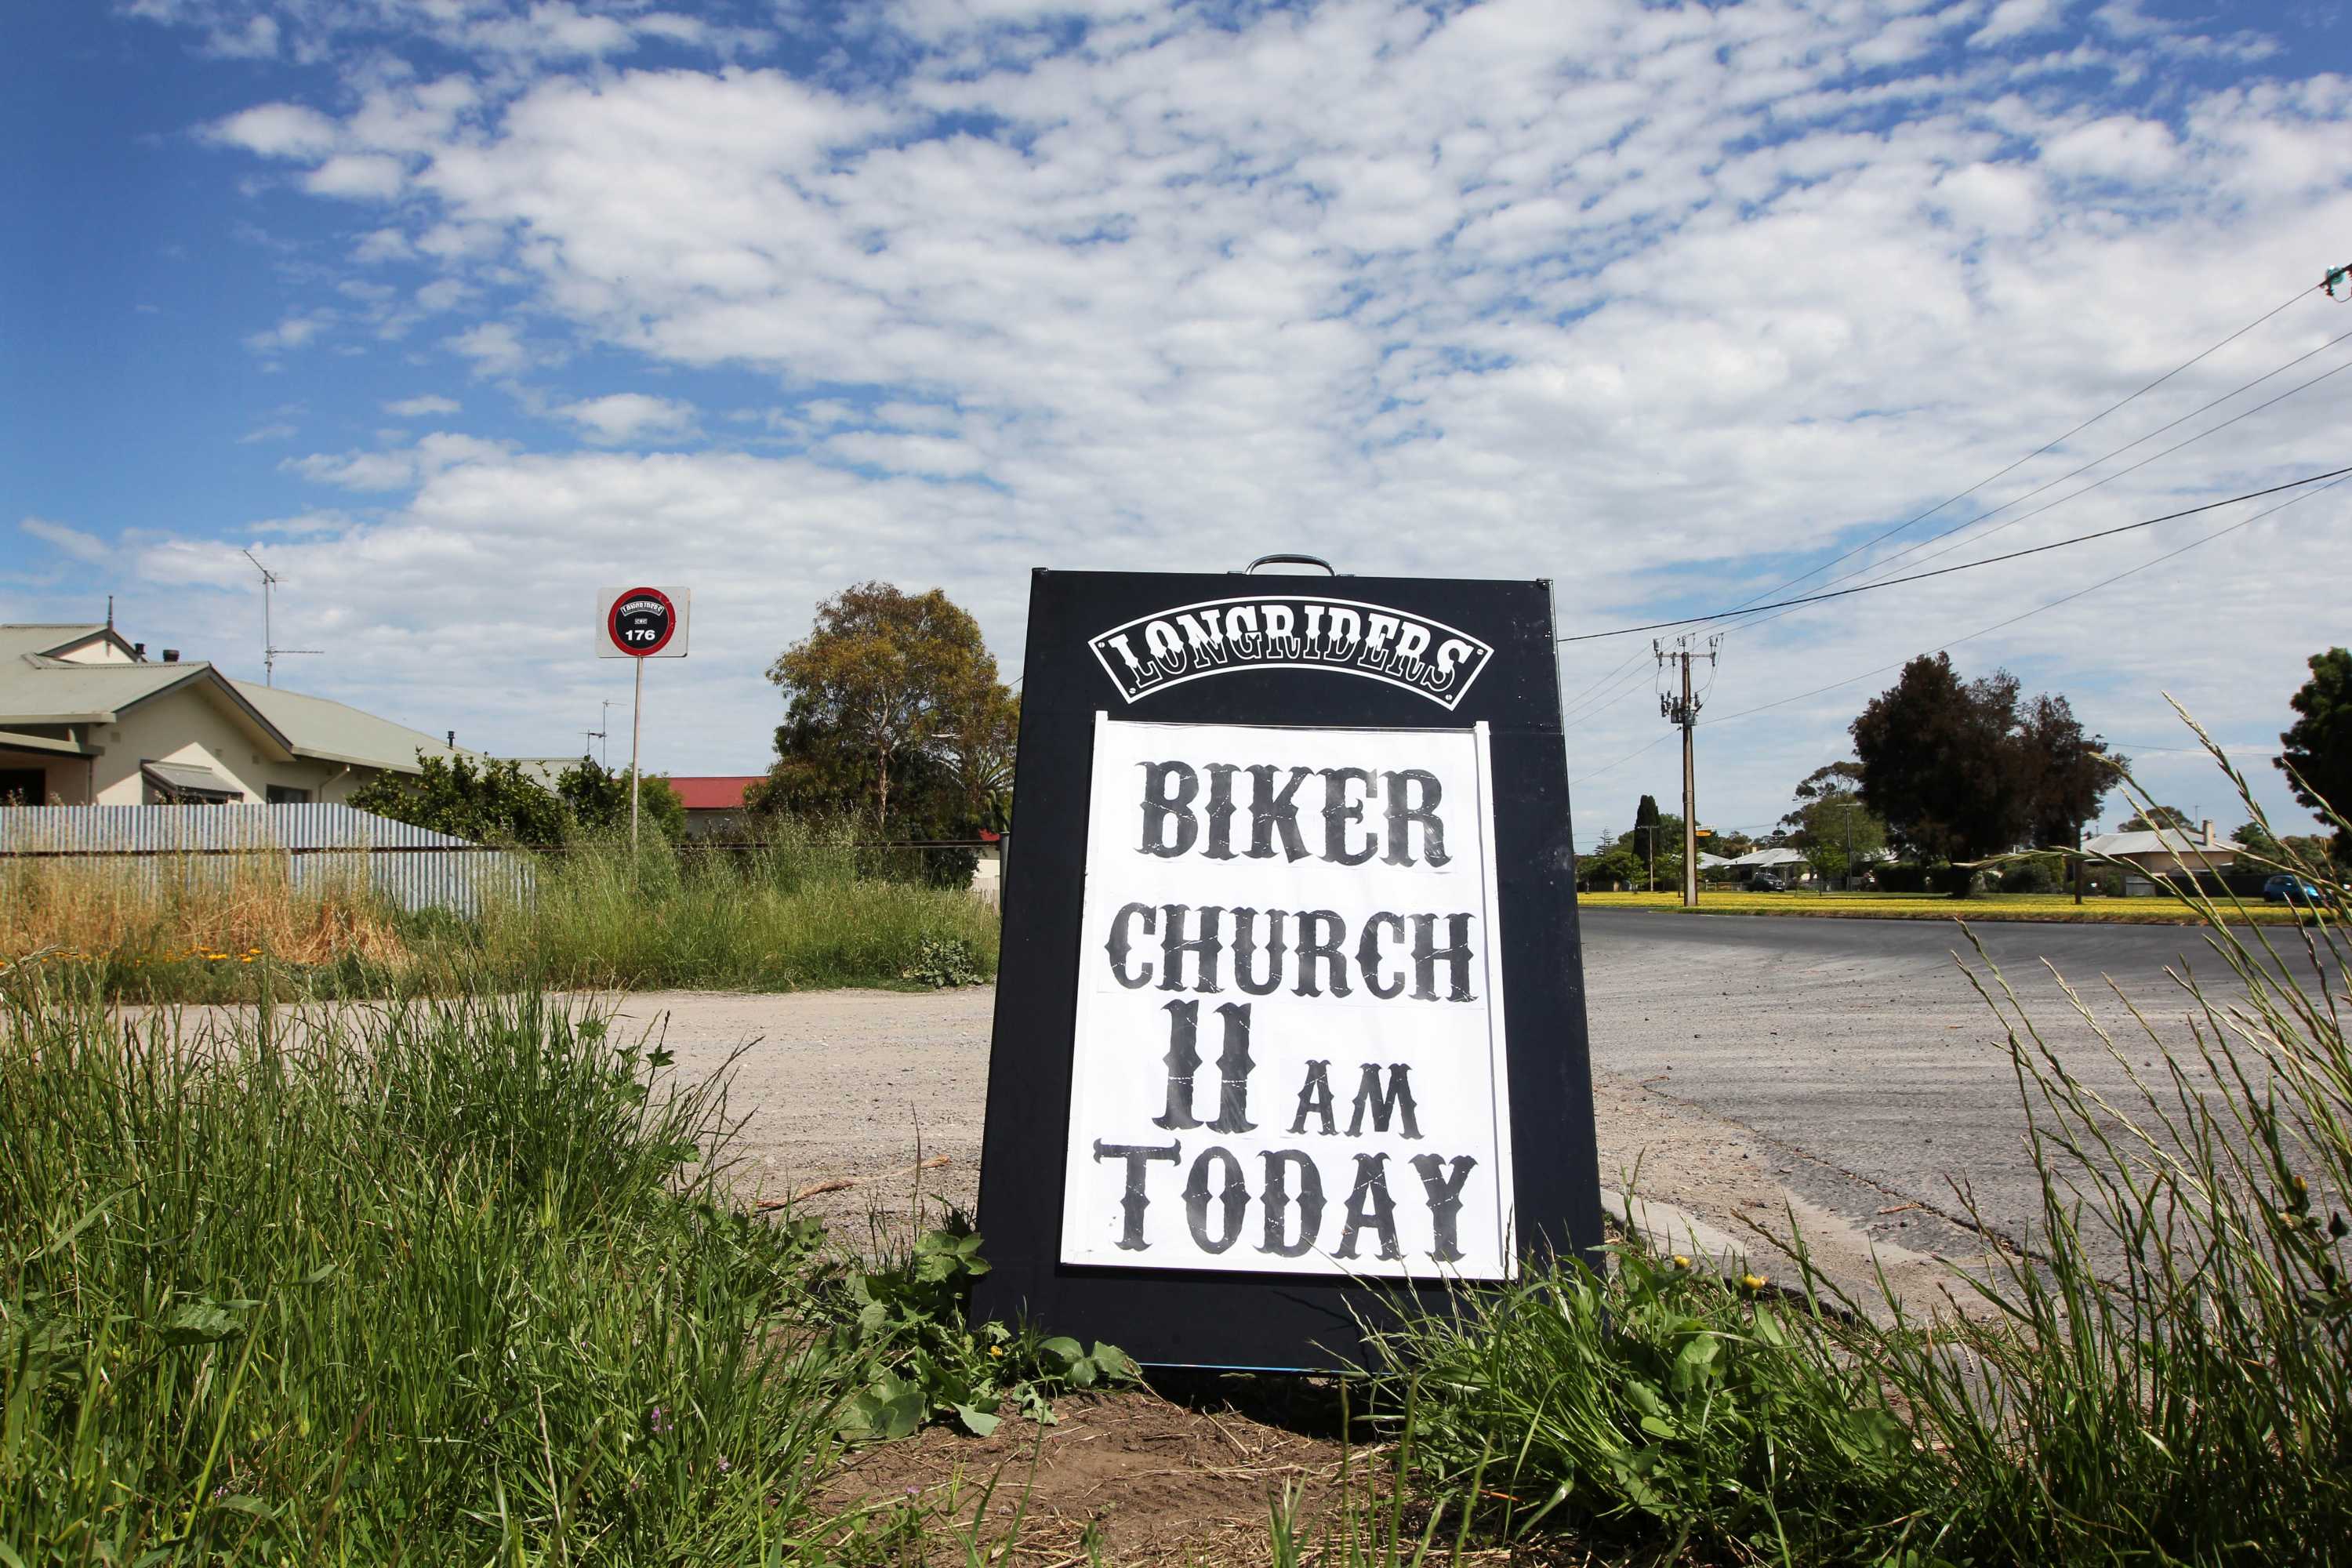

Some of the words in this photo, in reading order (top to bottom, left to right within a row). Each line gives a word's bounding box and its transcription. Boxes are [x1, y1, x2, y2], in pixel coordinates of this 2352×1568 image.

[626, 630, 655, 641] 176
[1108, 604, 1474, 693] LONGRIDERS
[1134, 760, 1453, 868] BIKER
[1104, 902, 1479, 1004] CHURCH
[1152, 999, 1259, 1134] 11
[1286, 1059, 1425, 1140] AM
[1093, 1138, 1479, 1263] TODAY
